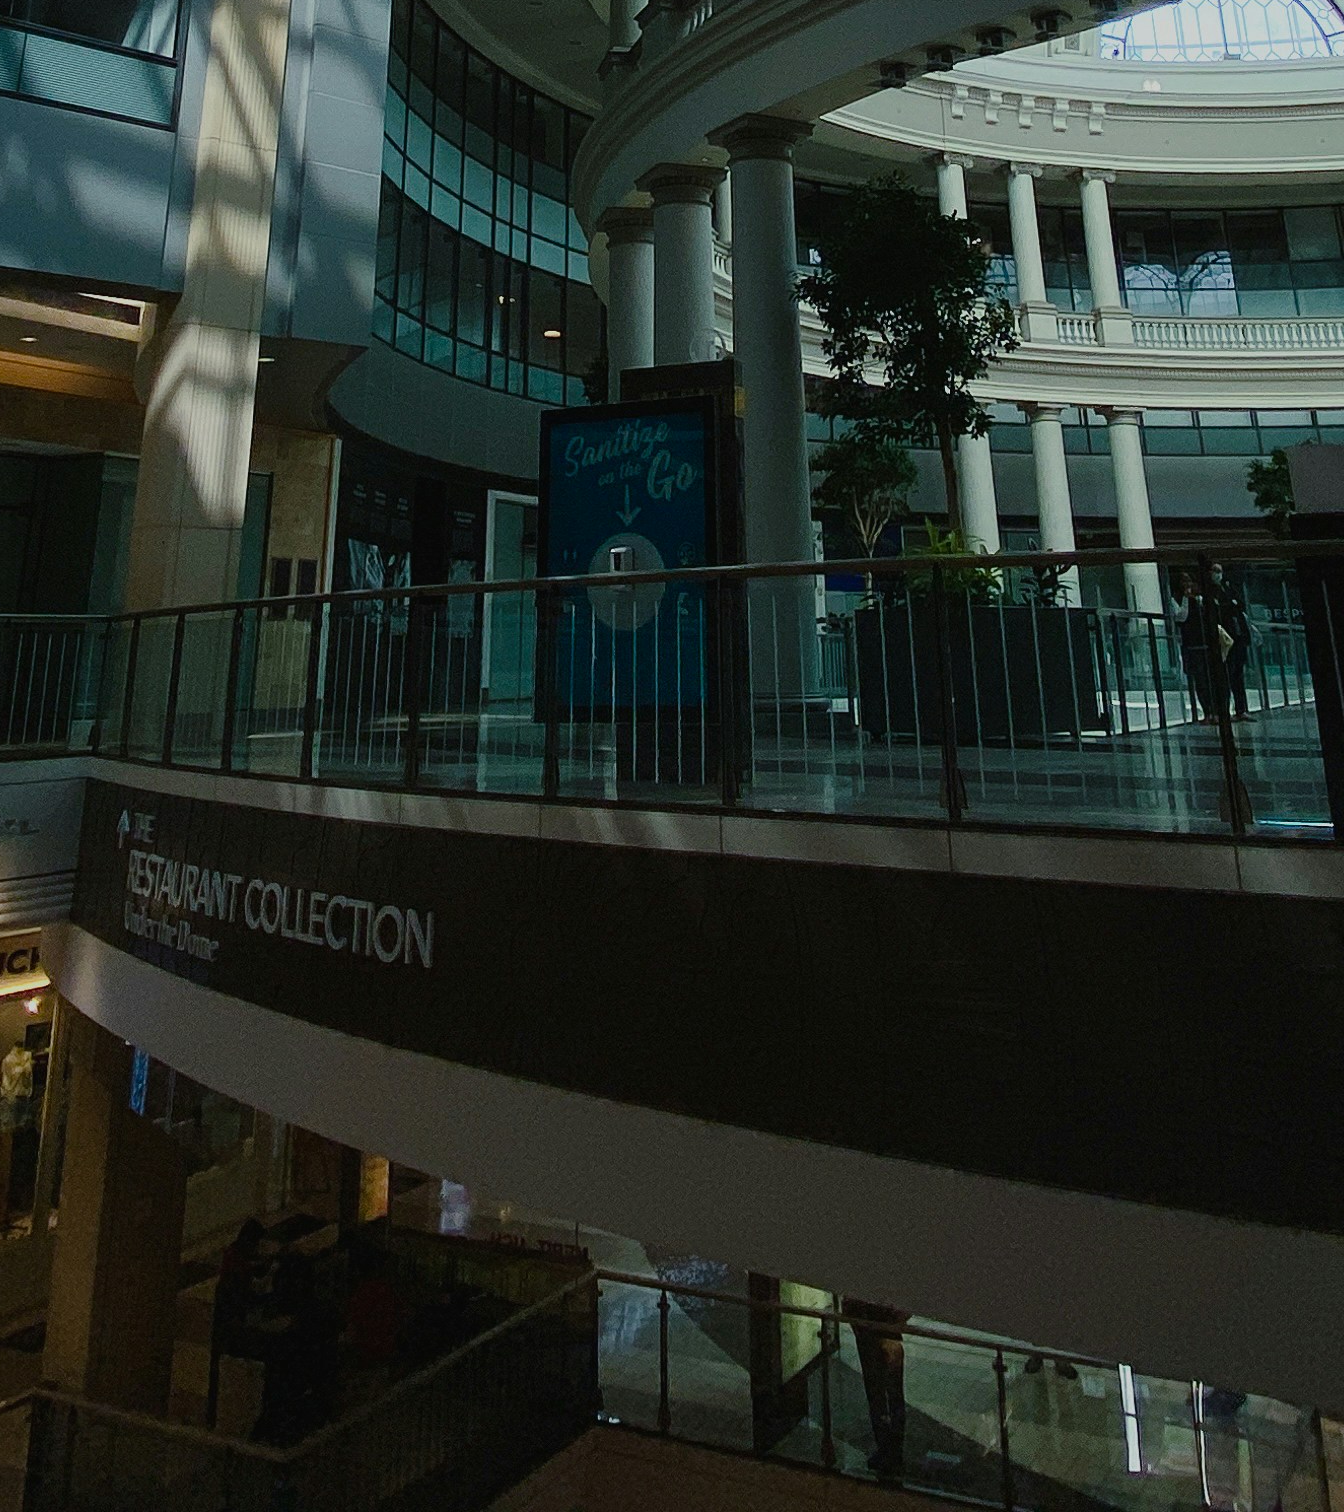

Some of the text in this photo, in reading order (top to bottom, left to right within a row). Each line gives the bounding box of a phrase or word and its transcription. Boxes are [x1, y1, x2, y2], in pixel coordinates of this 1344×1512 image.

[564, 418, 671, 478] Sanitize
[646, 448, 698, 502] Go
[126, 849, 435, 969] RESTAURANT COLLECTION
